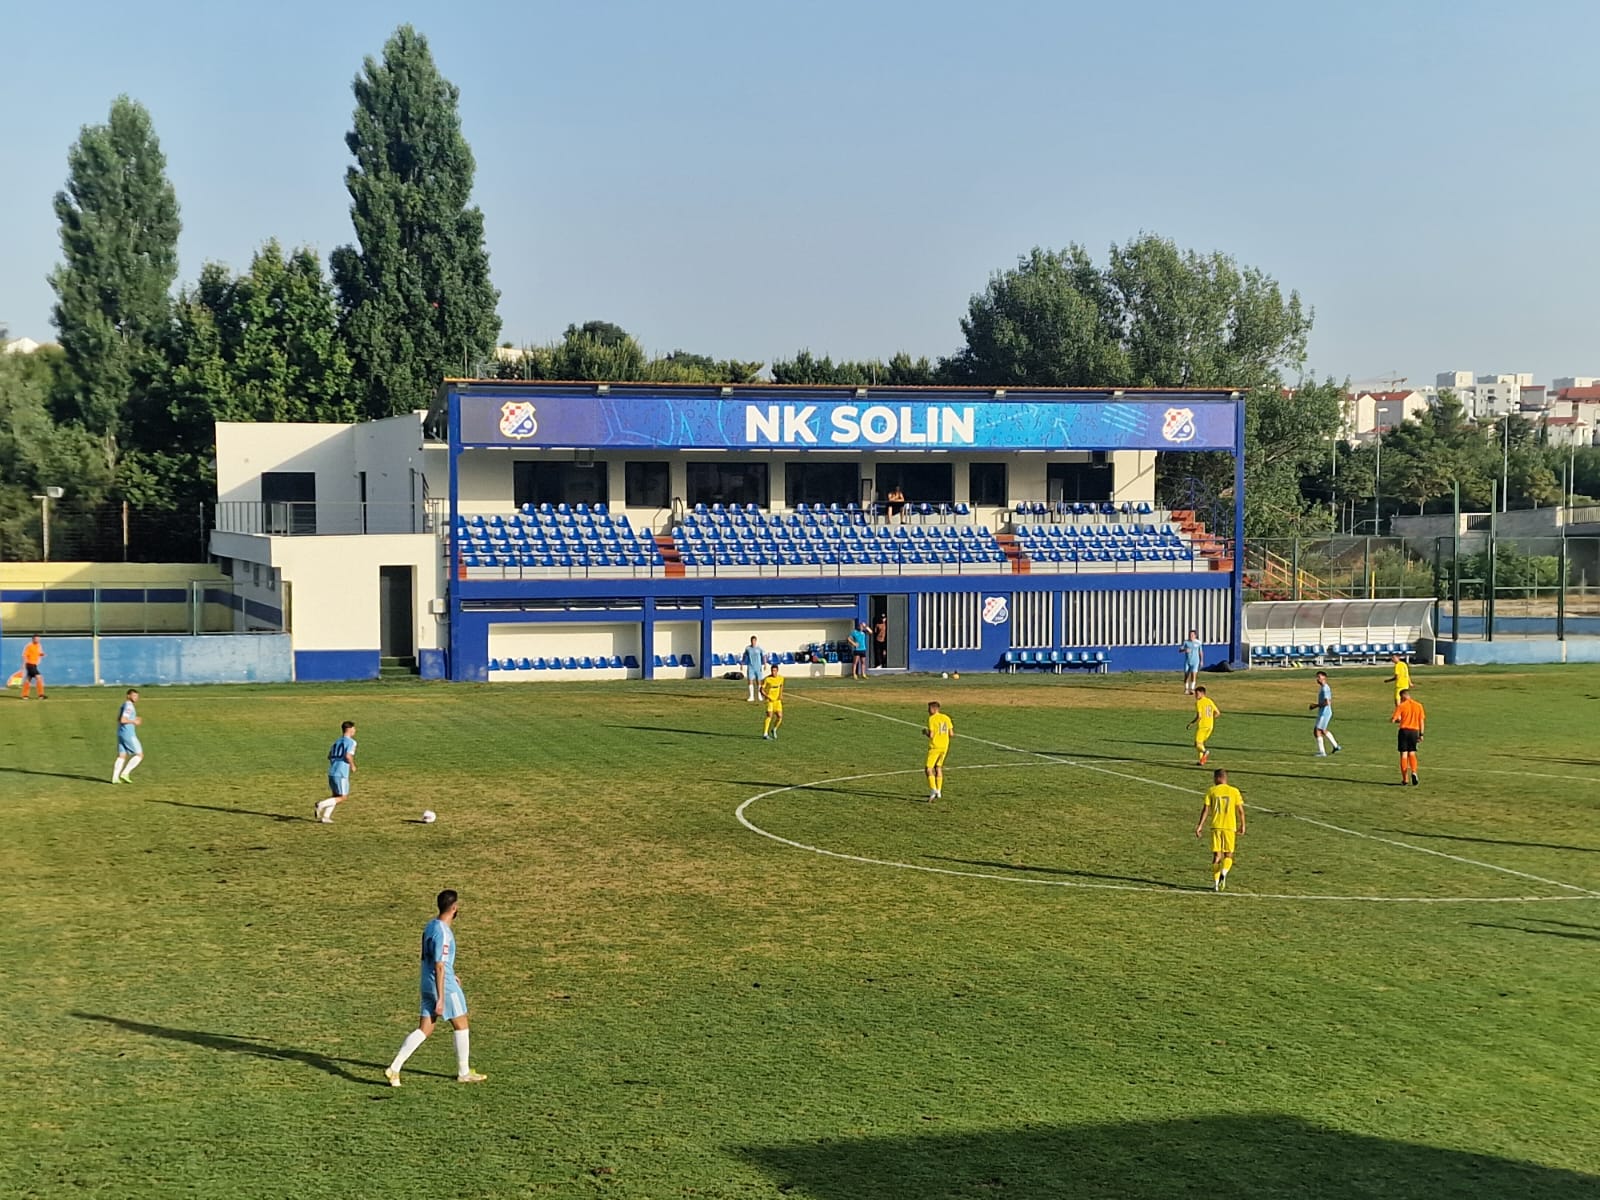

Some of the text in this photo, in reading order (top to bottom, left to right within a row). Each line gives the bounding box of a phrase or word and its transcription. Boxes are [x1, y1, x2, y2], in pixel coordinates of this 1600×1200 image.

[745, 405, 975, 444] NK SOLIN
[938, 721, 948, 736] 14
[331, 742, 345, 759] 10
[1216, 795, 1230, 814] 17
